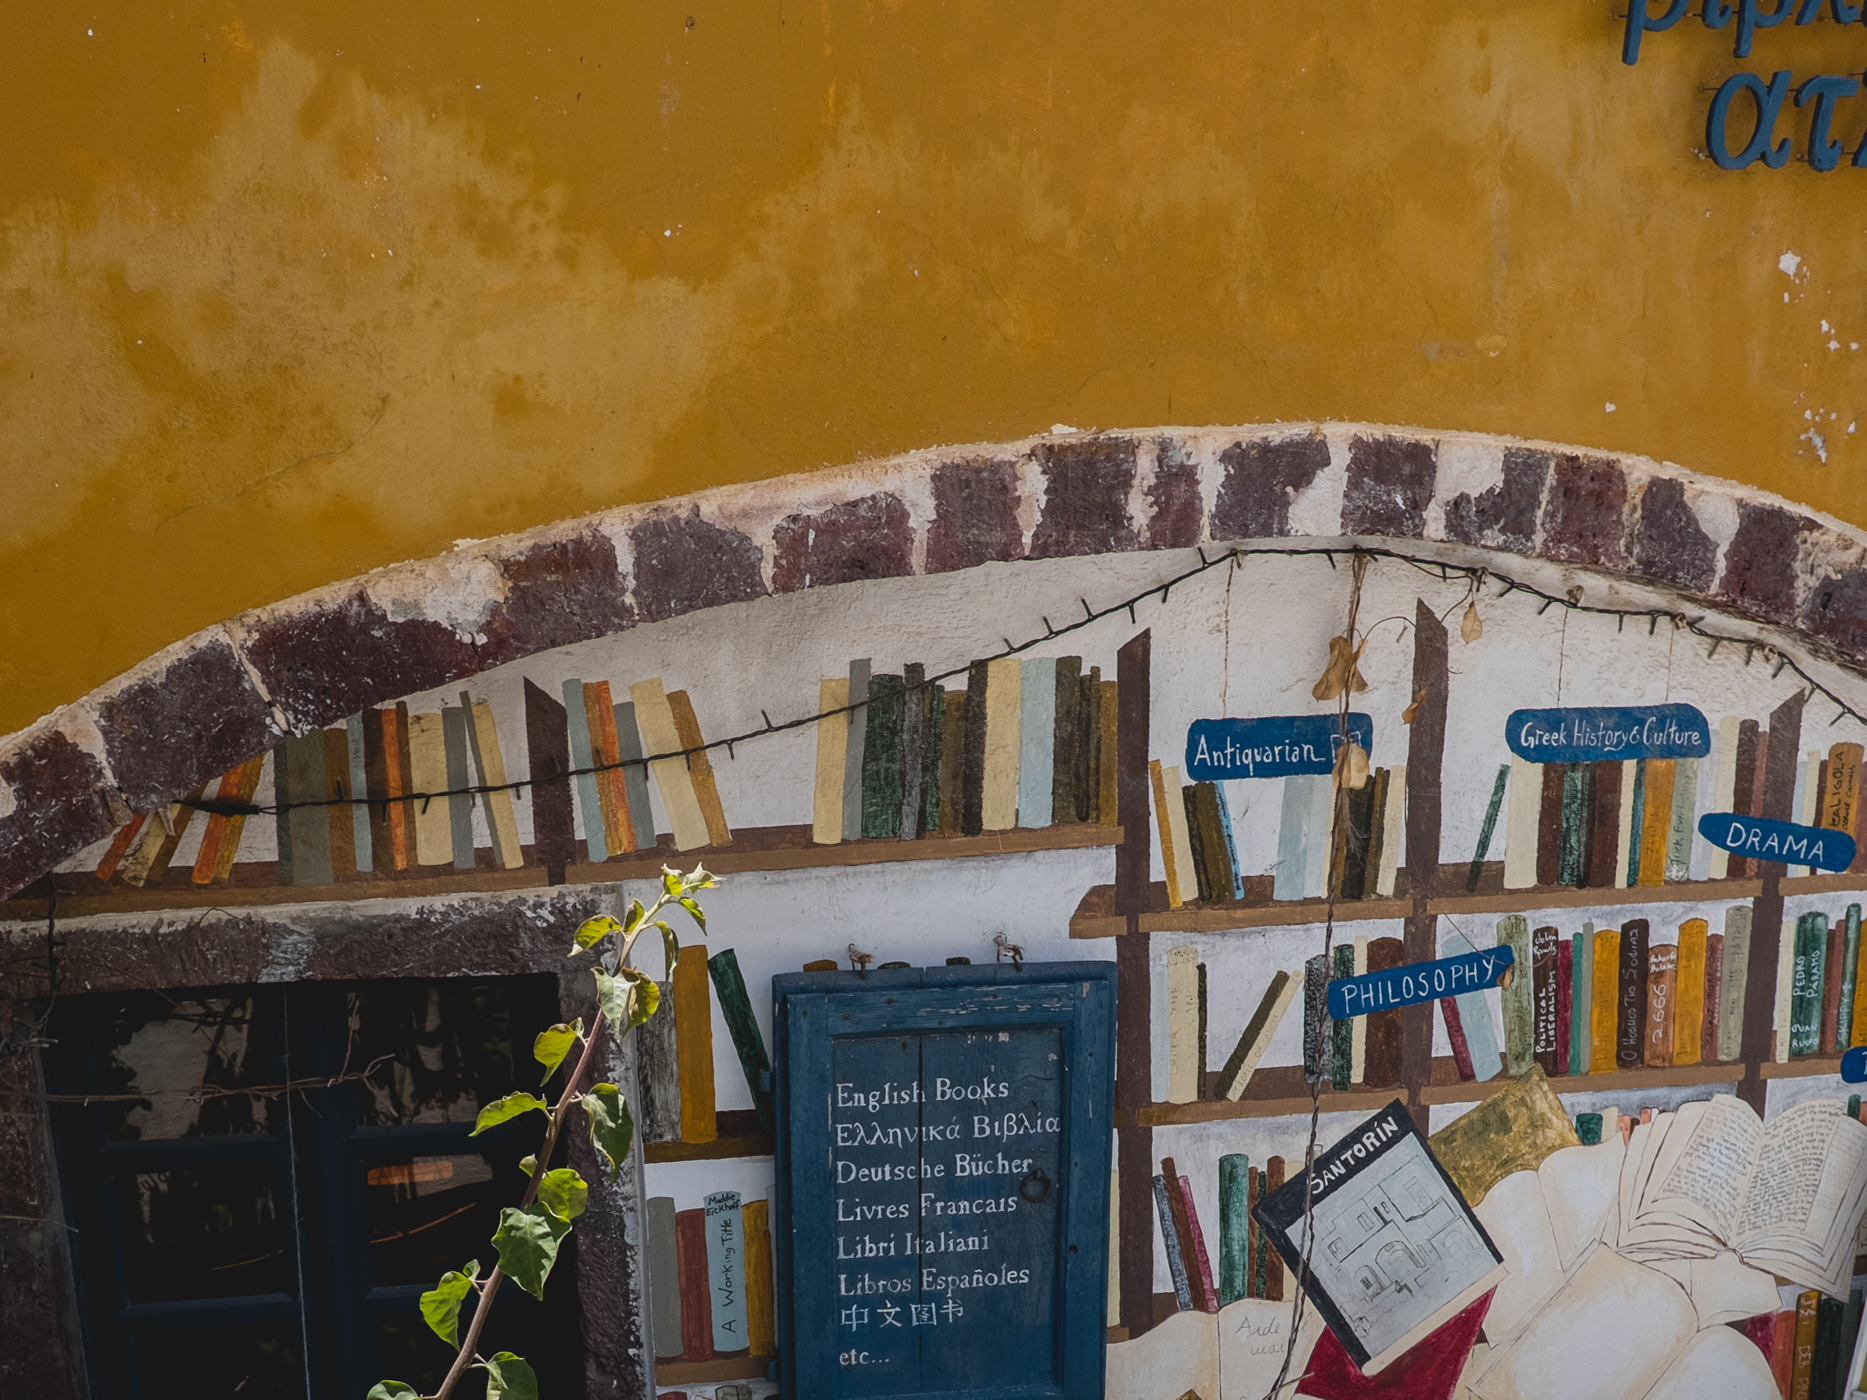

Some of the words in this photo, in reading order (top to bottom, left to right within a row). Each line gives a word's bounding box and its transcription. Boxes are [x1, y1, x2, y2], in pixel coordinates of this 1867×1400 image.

[1706, 69, 1867, 172] ατ
[1520, 721, 1568, 748] Greek
[1573, 719, 1629, 751] History
[1642, 717, 1702, 746] Culture
[1194, 734, 1326, 776] Antiquarian
[1725, 822, 1824, 863] DRAMA
[1341, 955, 1496, 1015] PHILOSOPHY
[1792, 955, 1806, 997] PEDRO
[1535, 987, 1546, 1053] POLITICAL
[1546, 970, 1557, 1052] LIBERALISM
[1652, 984, 1667, 1044] 2666
[1837, 995, 1851, 1042] SKIPPY
[836, 1081, 927, 1113] English
[935, 1076, 1010, 1101] Books
[835, 1115, 961, 1149] Ελληνικά
[972, 1112, 1061, 1143] Βιβλία
[836, 1157, 945, 1184] Deutsche
[955, 1152, 1033, 1178] Bücher
[1306, 1115, 1399, 1195] SANTORÍN
[836, 1197, 910, 1222] Livres
[920, 1192, 1018, 1217] Francais
[720, 1217, 733, 1247] Title
[836, 1232, 896, 1260] Libri
[904, 1228, 990, 1256] Italiani
[718, 1246, 736, 1308] Working
[837, 1272, 912, 1297] Libros
[920, 1262, 1031, 1298] Españoles
[720, 1318, 737, 1334] A
[840, 1298, 965, 1333] 中文图书
[838, 1347, 891, 1366] etc...
[1797, 1344, 1811, 1369] DER
